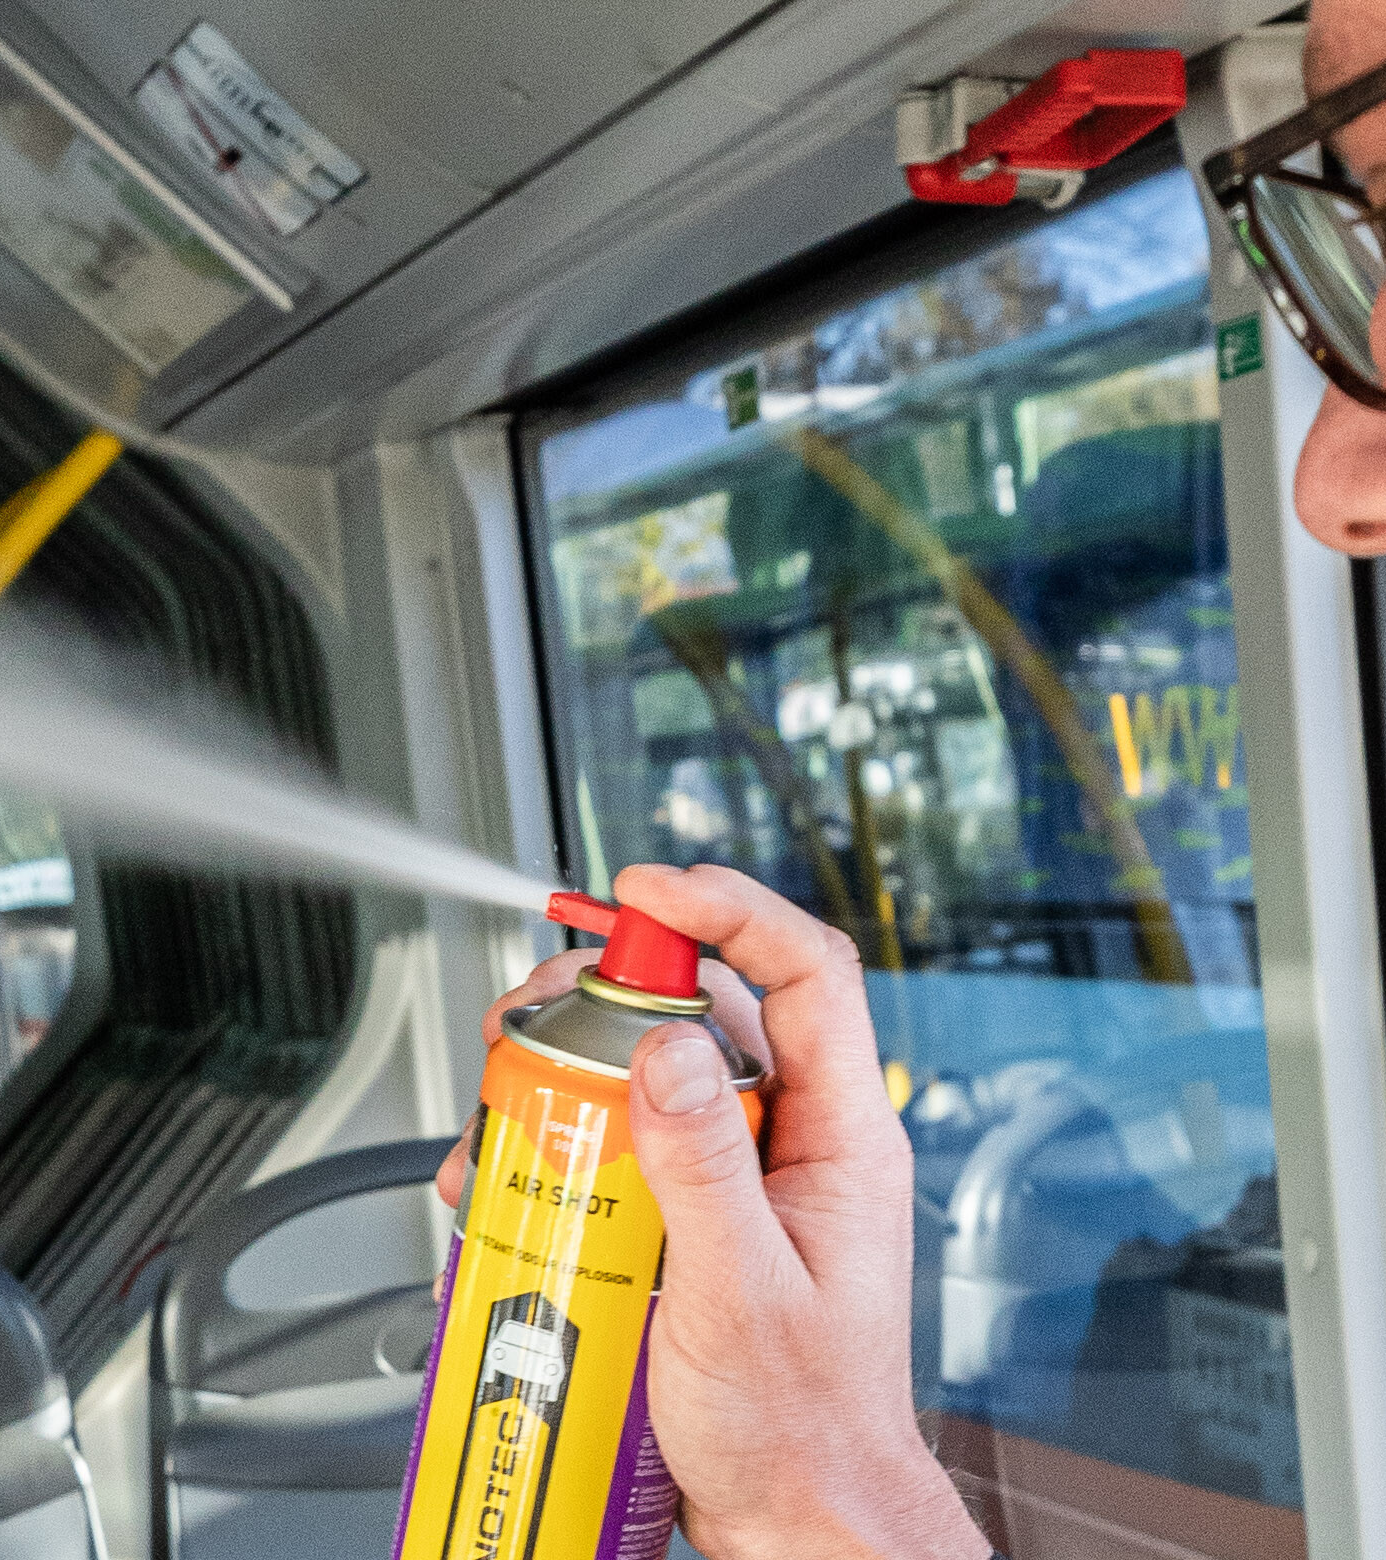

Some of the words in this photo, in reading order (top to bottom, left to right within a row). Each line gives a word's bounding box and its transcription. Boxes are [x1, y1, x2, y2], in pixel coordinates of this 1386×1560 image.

[507, 1171, 544, 1201] AIR
[548, 1185, 620, 1219] SHOT
[562, 1263, 635, 1286] EXPLOSION
